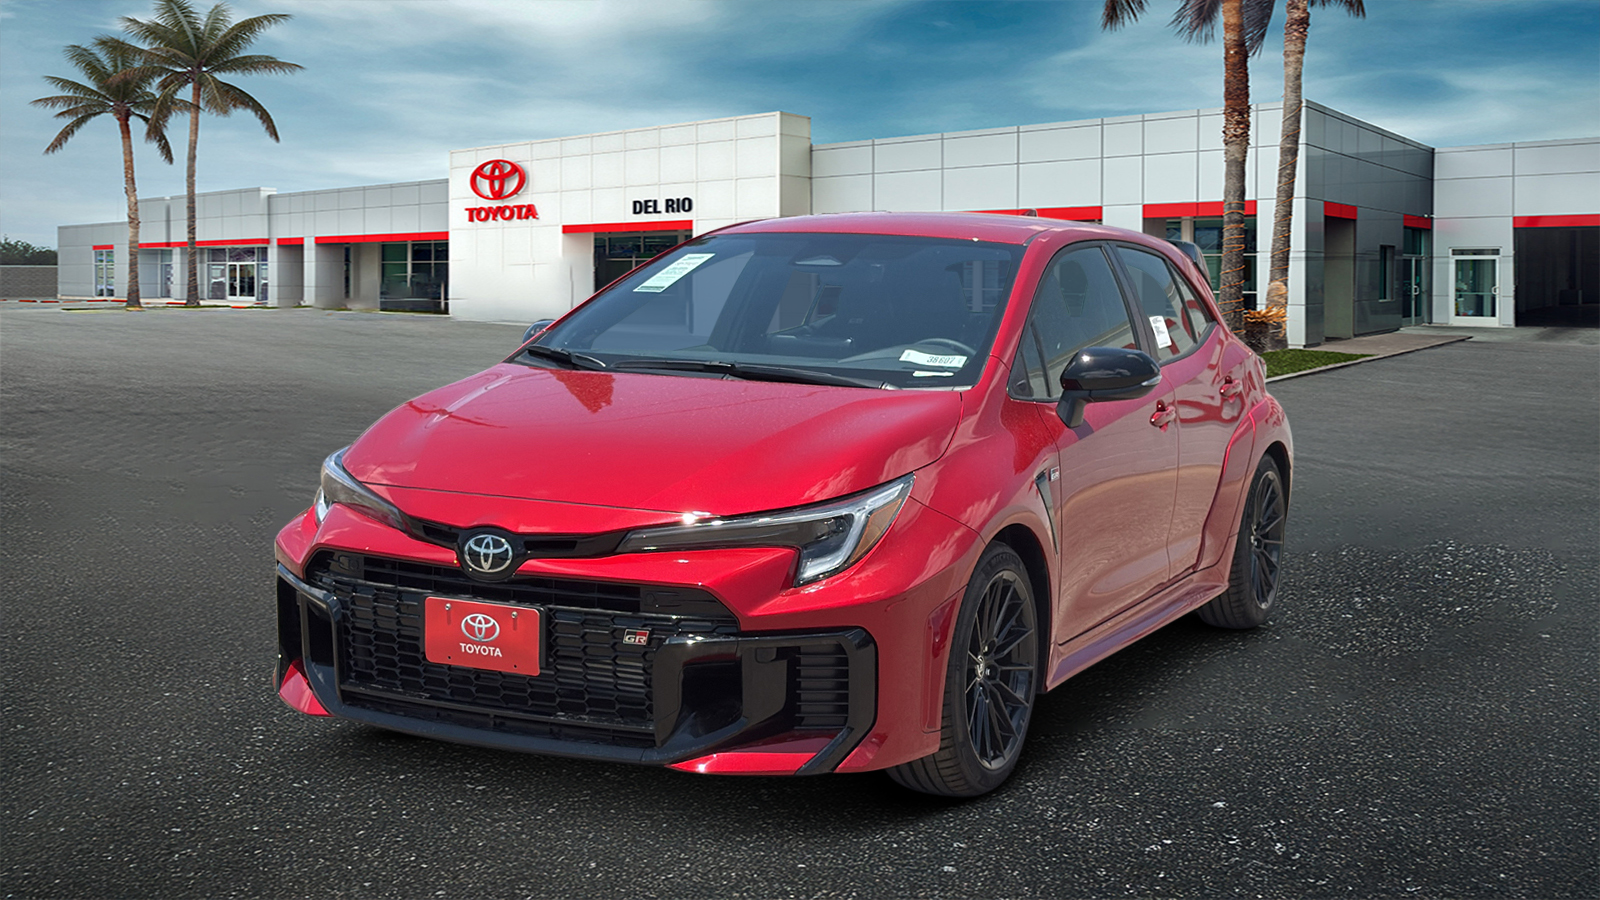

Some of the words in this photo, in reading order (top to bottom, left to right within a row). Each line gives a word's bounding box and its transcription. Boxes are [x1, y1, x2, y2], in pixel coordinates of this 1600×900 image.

[465, 204, 538, 222] TOYOTA
[632, 200, 661, 214] DEL
[665, 197, 693, 213] RIO
[459, 642, 502, 657] TOYOTA
